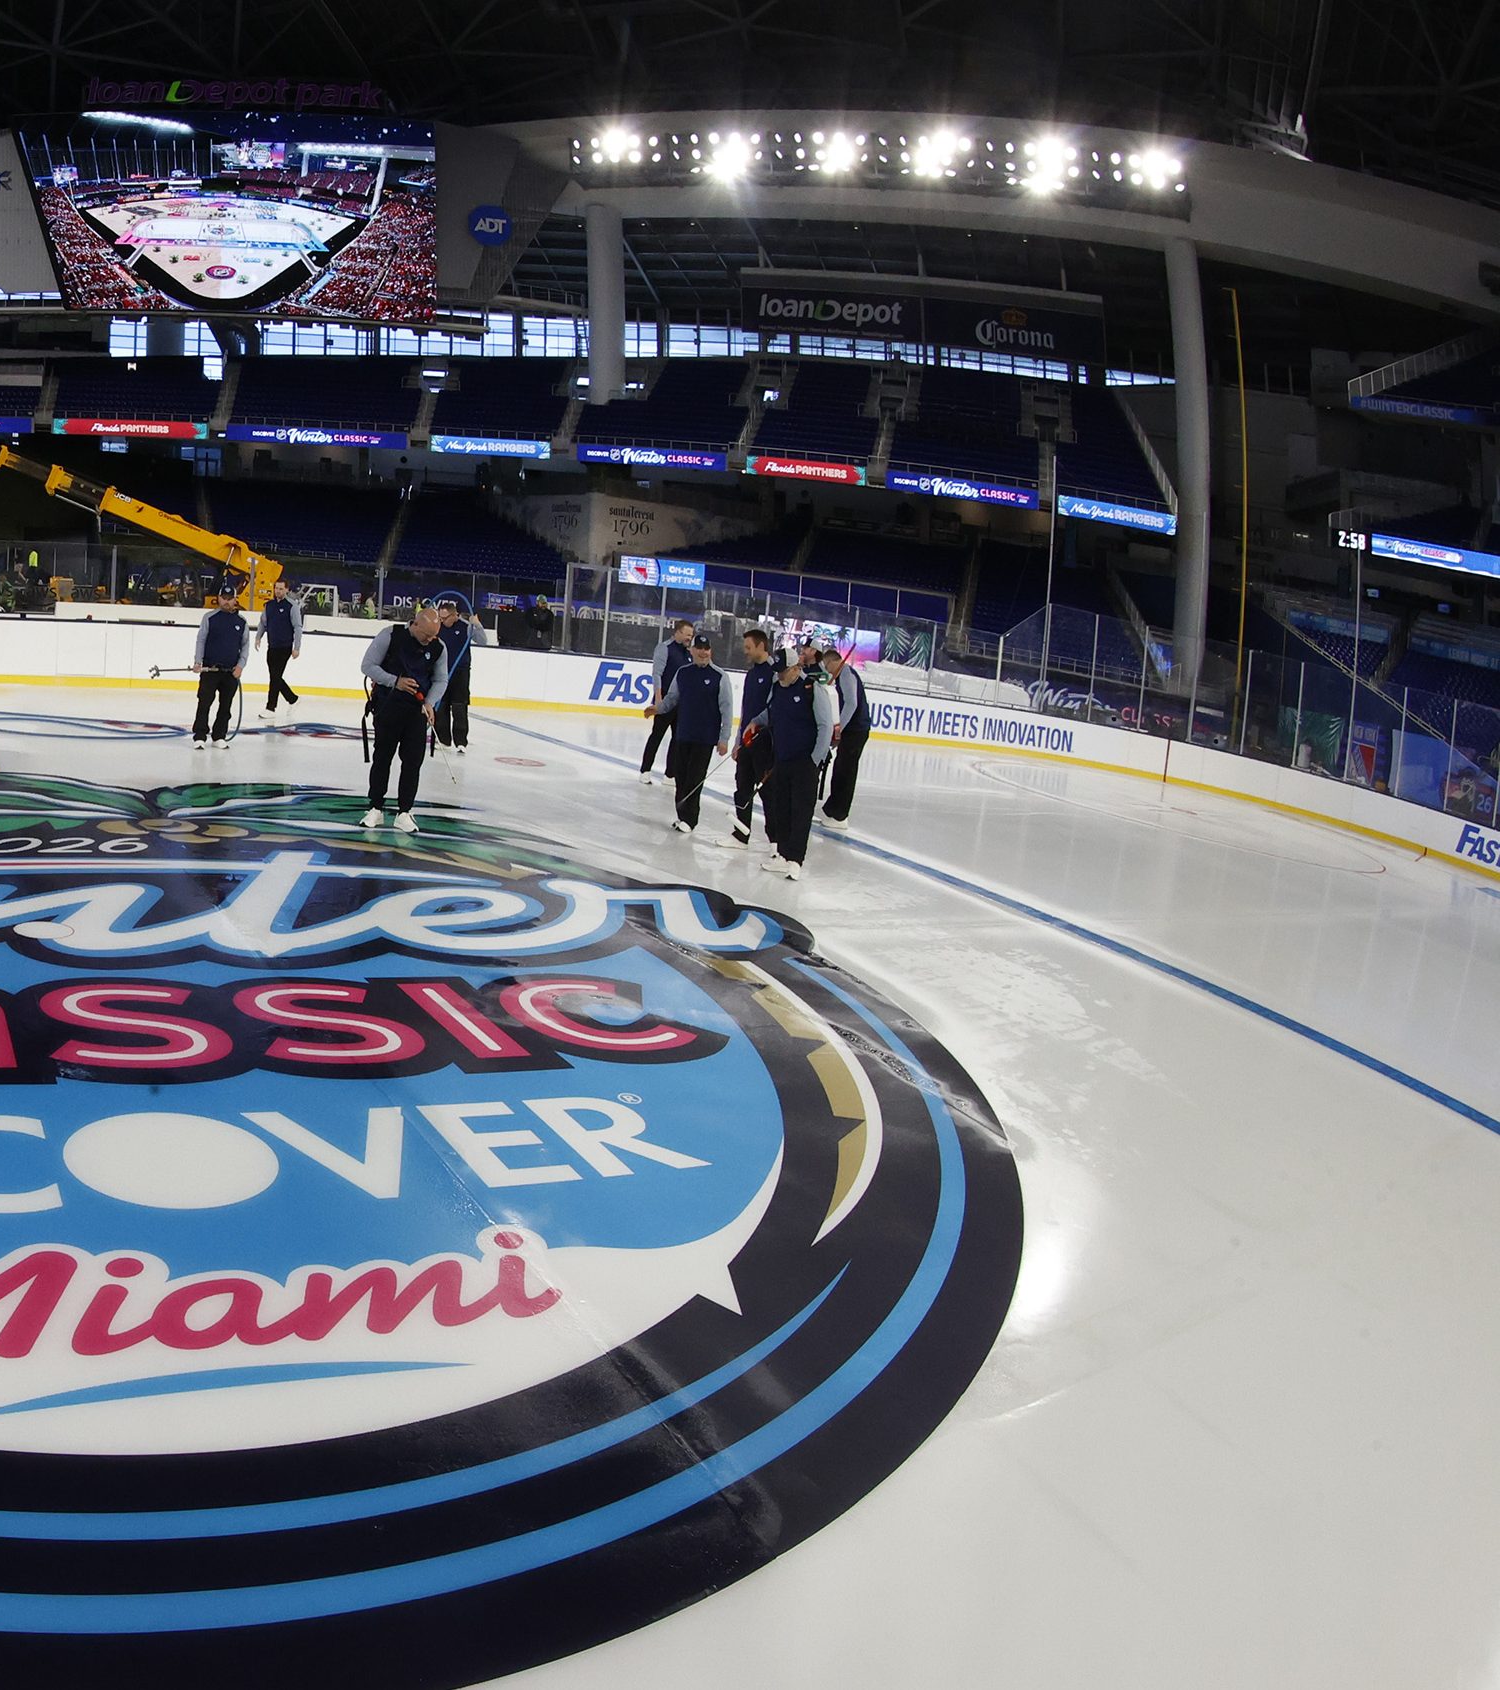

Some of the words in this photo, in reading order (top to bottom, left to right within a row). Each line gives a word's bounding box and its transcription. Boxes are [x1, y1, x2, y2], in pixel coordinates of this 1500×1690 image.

[86, 77, 289, 110] loanDepot
[293, 80, 382, 111] park
[474, 217, 507, 234] ADT
[759, 293, 903, 328] loanDepot
[975, 319, 1055, 350] Corona
[91, 423, 120, 432] Florida
[120, 424, 169, 434] PANTHERS
[287, 428, 333, 443] Winter
[334, 434, 368, 443] CLASSIC
[445, 440, 466, 450] New
[465, 441, 487, 453] York
[488, 442, 536, 454] RANGERS
[621, 447, 667, 464] Winter
[667, 455, 702, 464] CLASSIC
[764, 461, 795, 474] Florida
[795, 465, 847, 479] PANTHERS
[114, 492, 132, 503] JCB
[894, 477, 918, 486] DISCOVER
[931, 477, 980, 498] Winter
[980, 488, 1016, 501] CLASSIC
[1070, 503, 1091, 514] New
[1090, 505, 1114, 519] York
[1114, 509, 1164, 528] RANGERS
[613, 519, 651, 538] 1796
[1338, 531, 1366, 550] 2:58
[668, 565, 696, 576] ON-ICE
[681, 576, 701, 585] TIME
[588, 661, 654, 704] FAS
[927, 710, 979, 739] MEETS
[1476, 793, 1494, 814] 26
